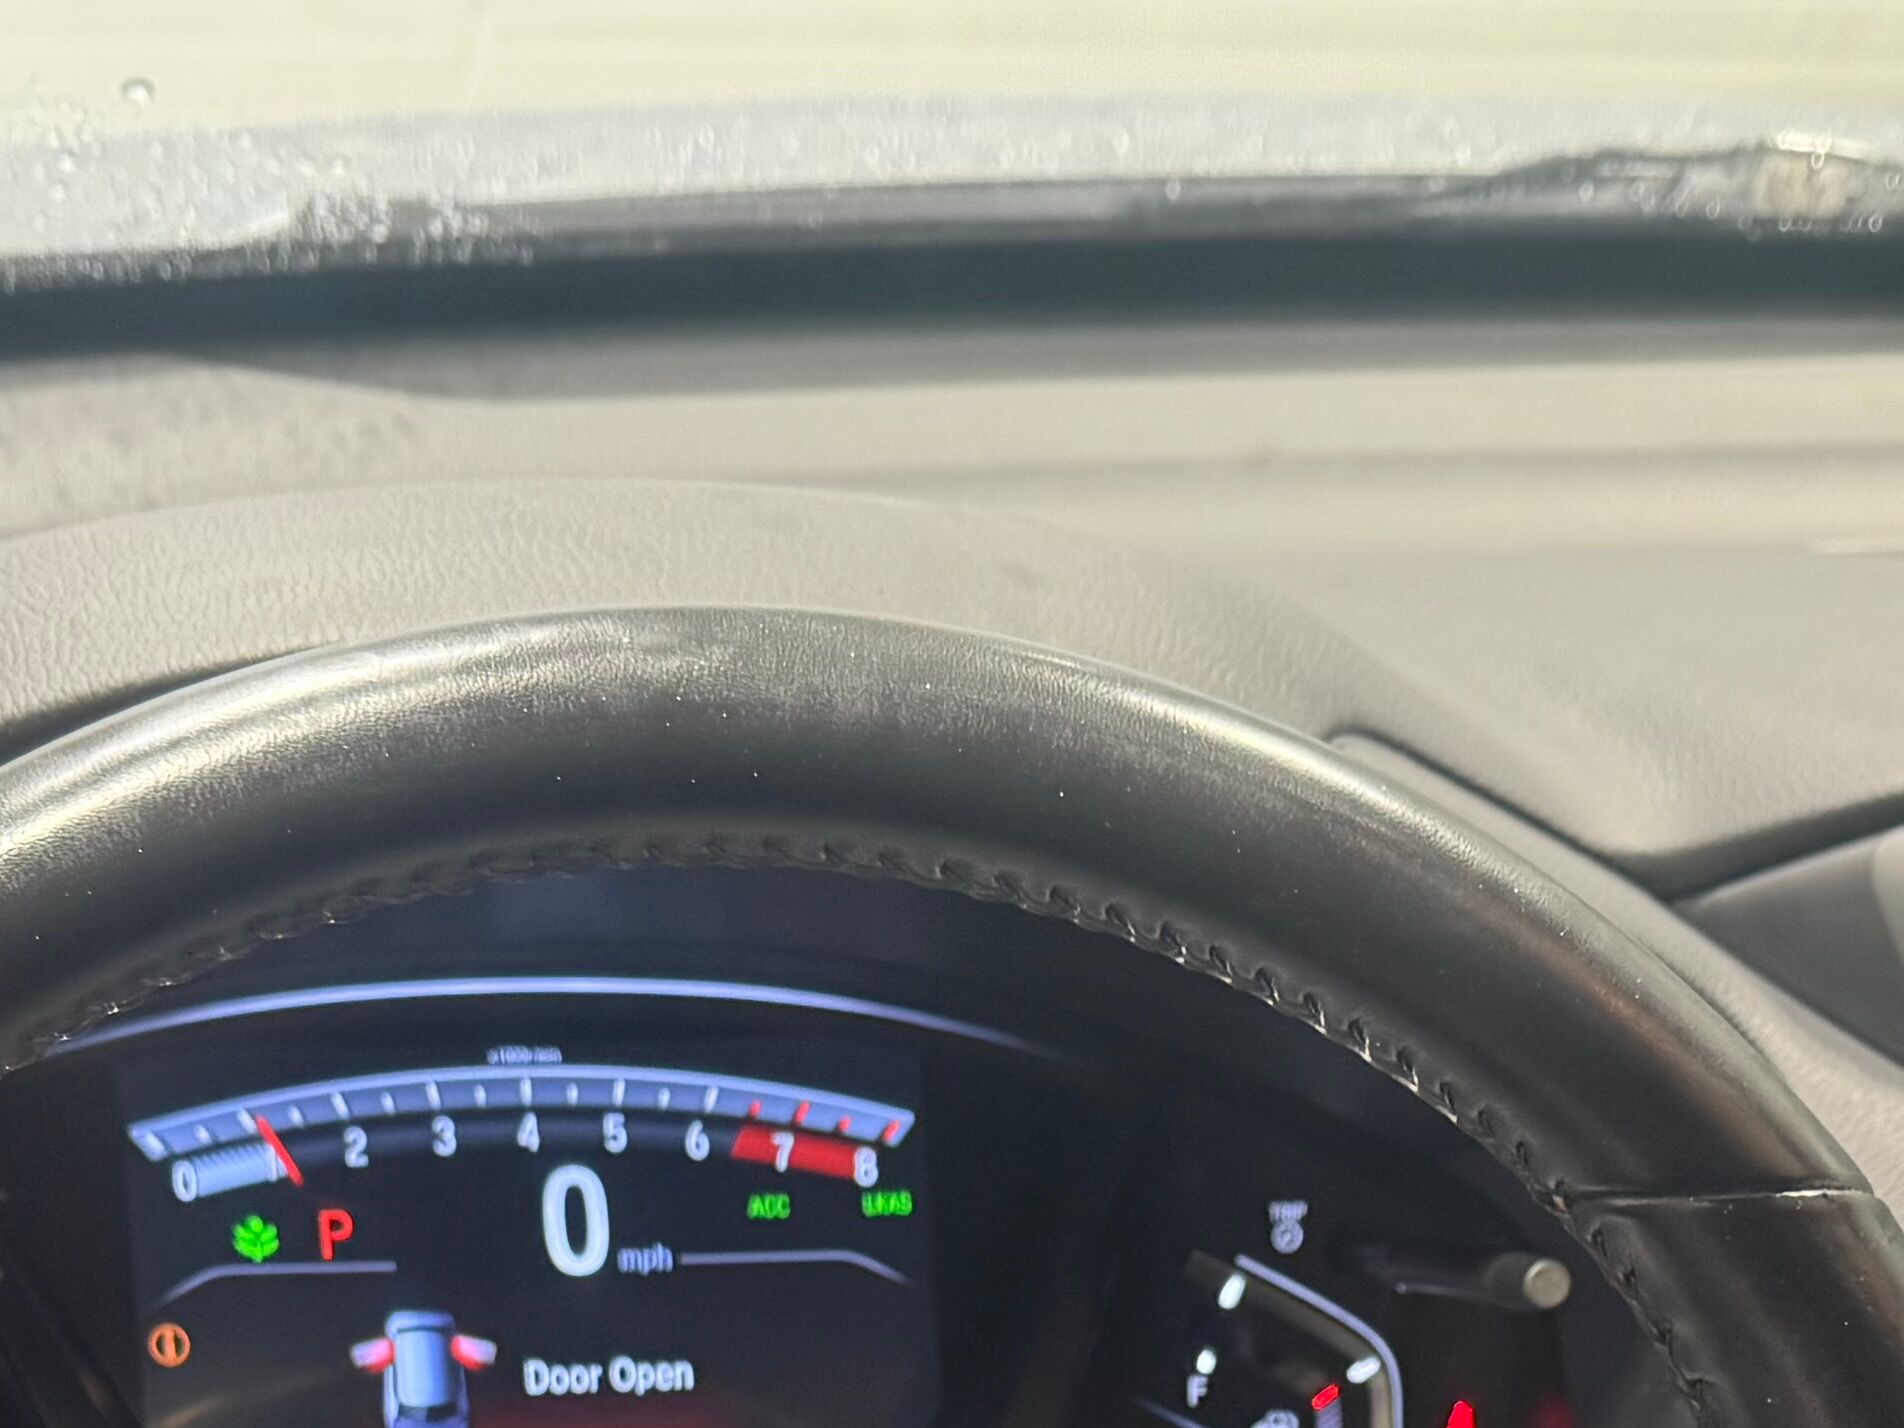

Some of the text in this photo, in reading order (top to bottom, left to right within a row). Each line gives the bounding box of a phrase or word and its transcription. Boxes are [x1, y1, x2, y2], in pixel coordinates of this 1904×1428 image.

[172, 1159, 198, 1203] 0
[343, 1126, 369, 1168] 2
[431, 1115, 457, 1157] 3
[517, 1111, 540, 1153] 4
[603, 1112, 628, 1154] 5
[685, 1119, 710, 1161] 6
[770, 1131, 795, 1173] 7
[854, 1146, 879, 1188] 8
[317, 1208, 354, 1261] P
[542, 1164, 673, 1278] 0 mph
[523, 1354, 695, 1397] Door Open
